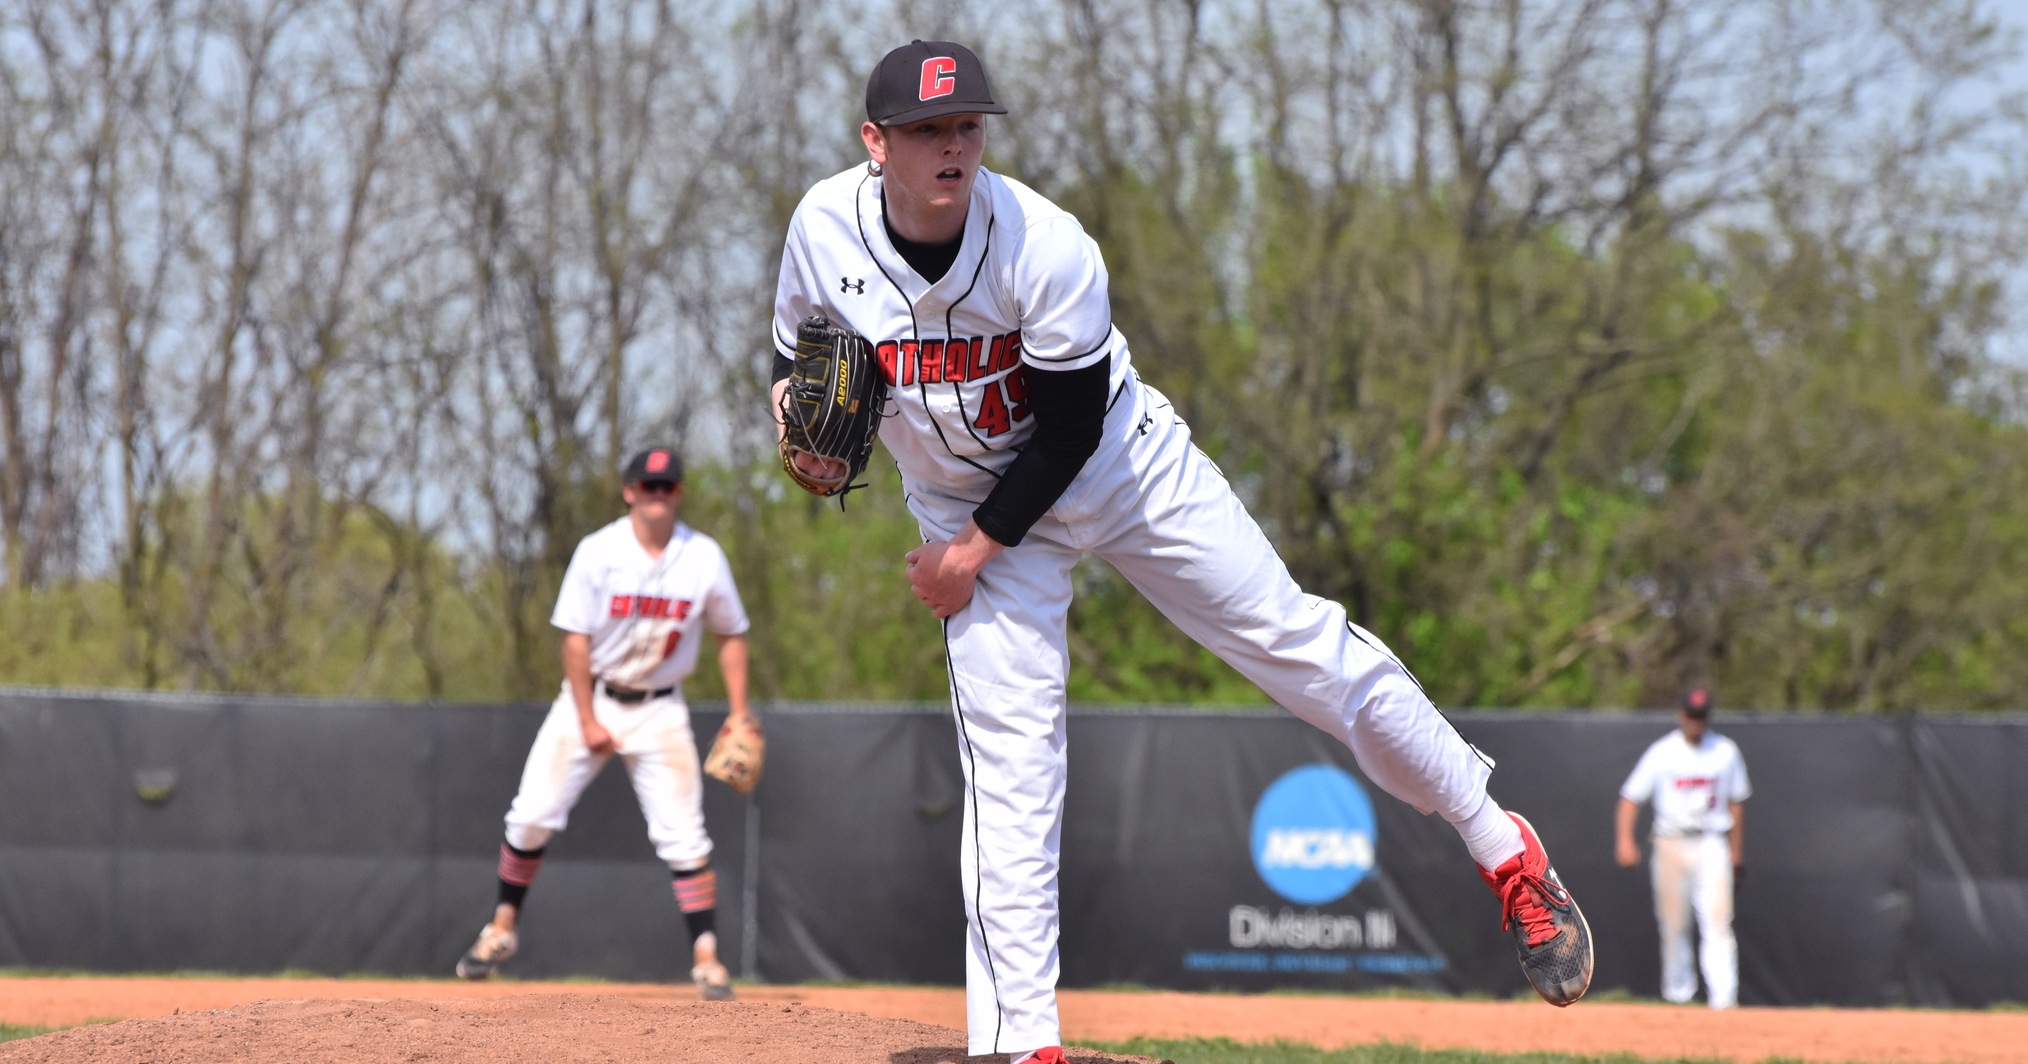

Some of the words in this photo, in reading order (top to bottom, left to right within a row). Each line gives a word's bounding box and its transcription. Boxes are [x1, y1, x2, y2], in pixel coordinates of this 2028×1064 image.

[918, 56, 956, 101] C
[836, 360, 848, 407] A2000
[1262, 829, 1376, 870] NCAA
[1229, 904, 1363, 949] Division
